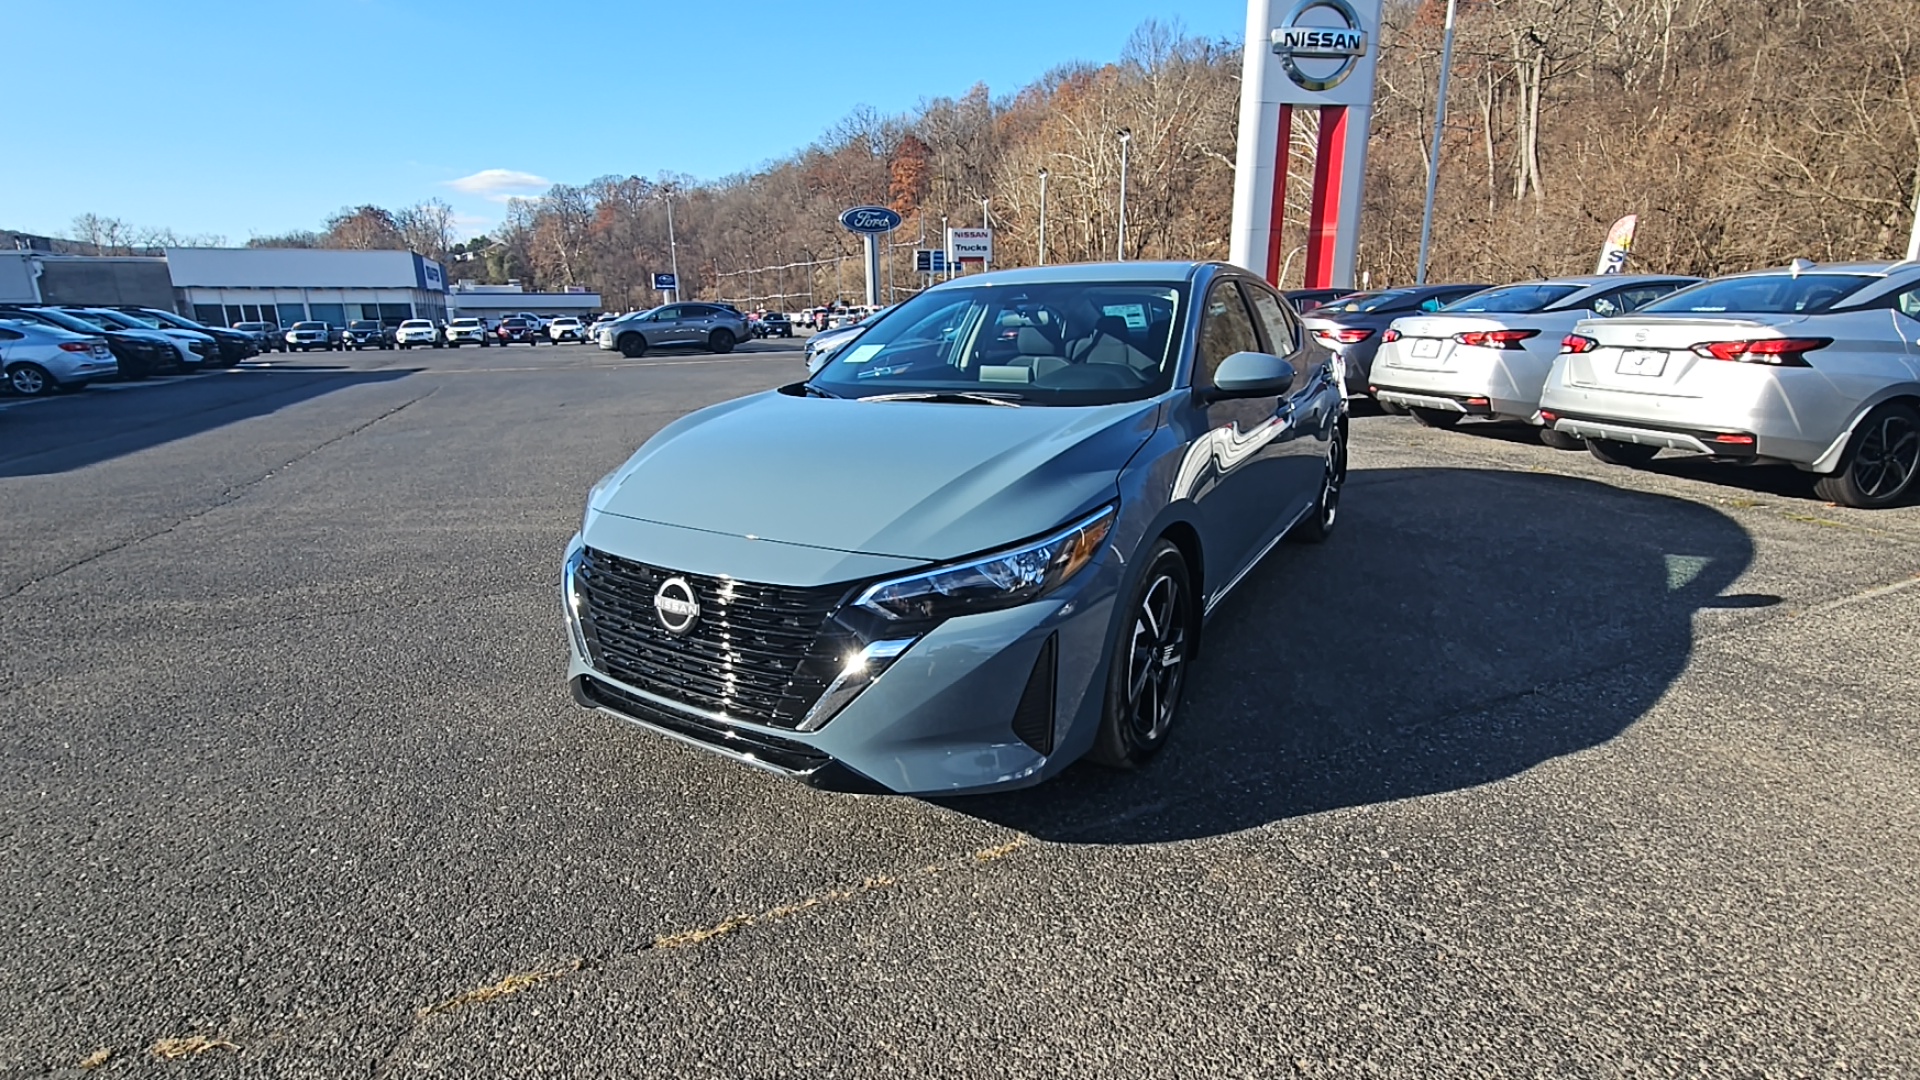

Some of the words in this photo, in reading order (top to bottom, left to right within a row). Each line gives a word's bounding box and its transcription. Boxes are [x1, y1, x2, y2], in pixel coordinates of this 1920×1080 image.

[1284, 32, 1360, 49] NISSAN
[854, 211, 889, 228] Ford
[954, 231, 988, 239] NISSAN
[956, 244, 988, 252] Trucks
[655, 597, 698, 616] NISSAN
